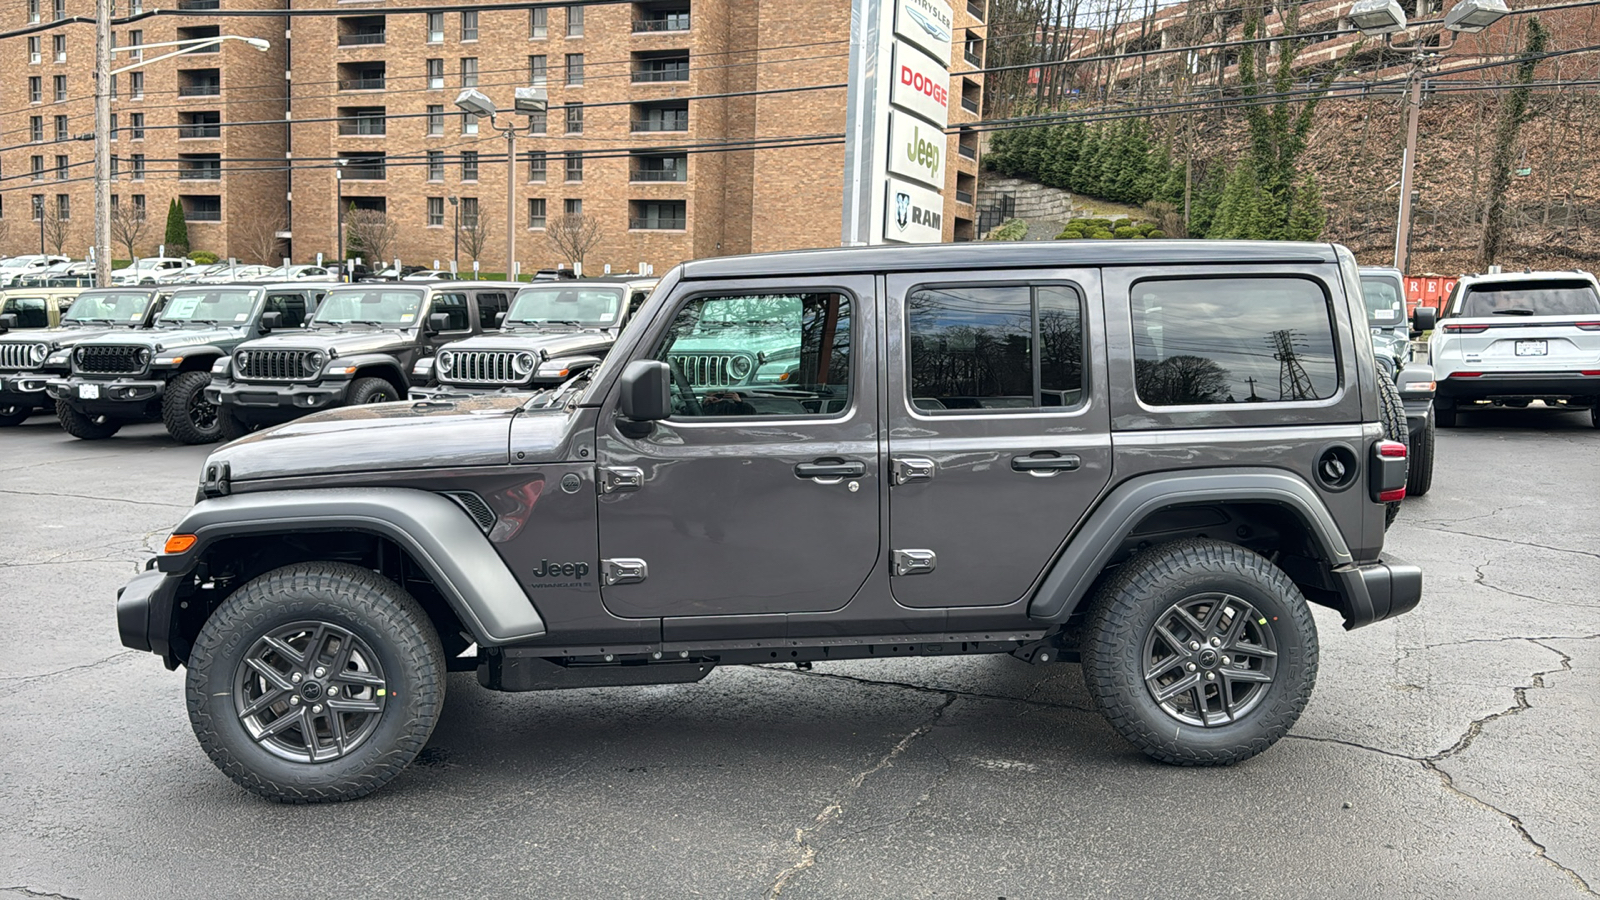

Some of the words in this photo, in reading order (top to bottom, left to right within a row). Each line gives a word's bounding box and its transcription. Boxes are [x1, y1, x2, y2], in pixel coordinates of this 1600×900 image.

[908, 0, 951, 29] RYSLER
[901, 65, 947, 107] DODGE
[907, 126, 940, 178] Jeep
[912, 206, 941, 231] RAM
[533, 558, 589, 579] Jeep
